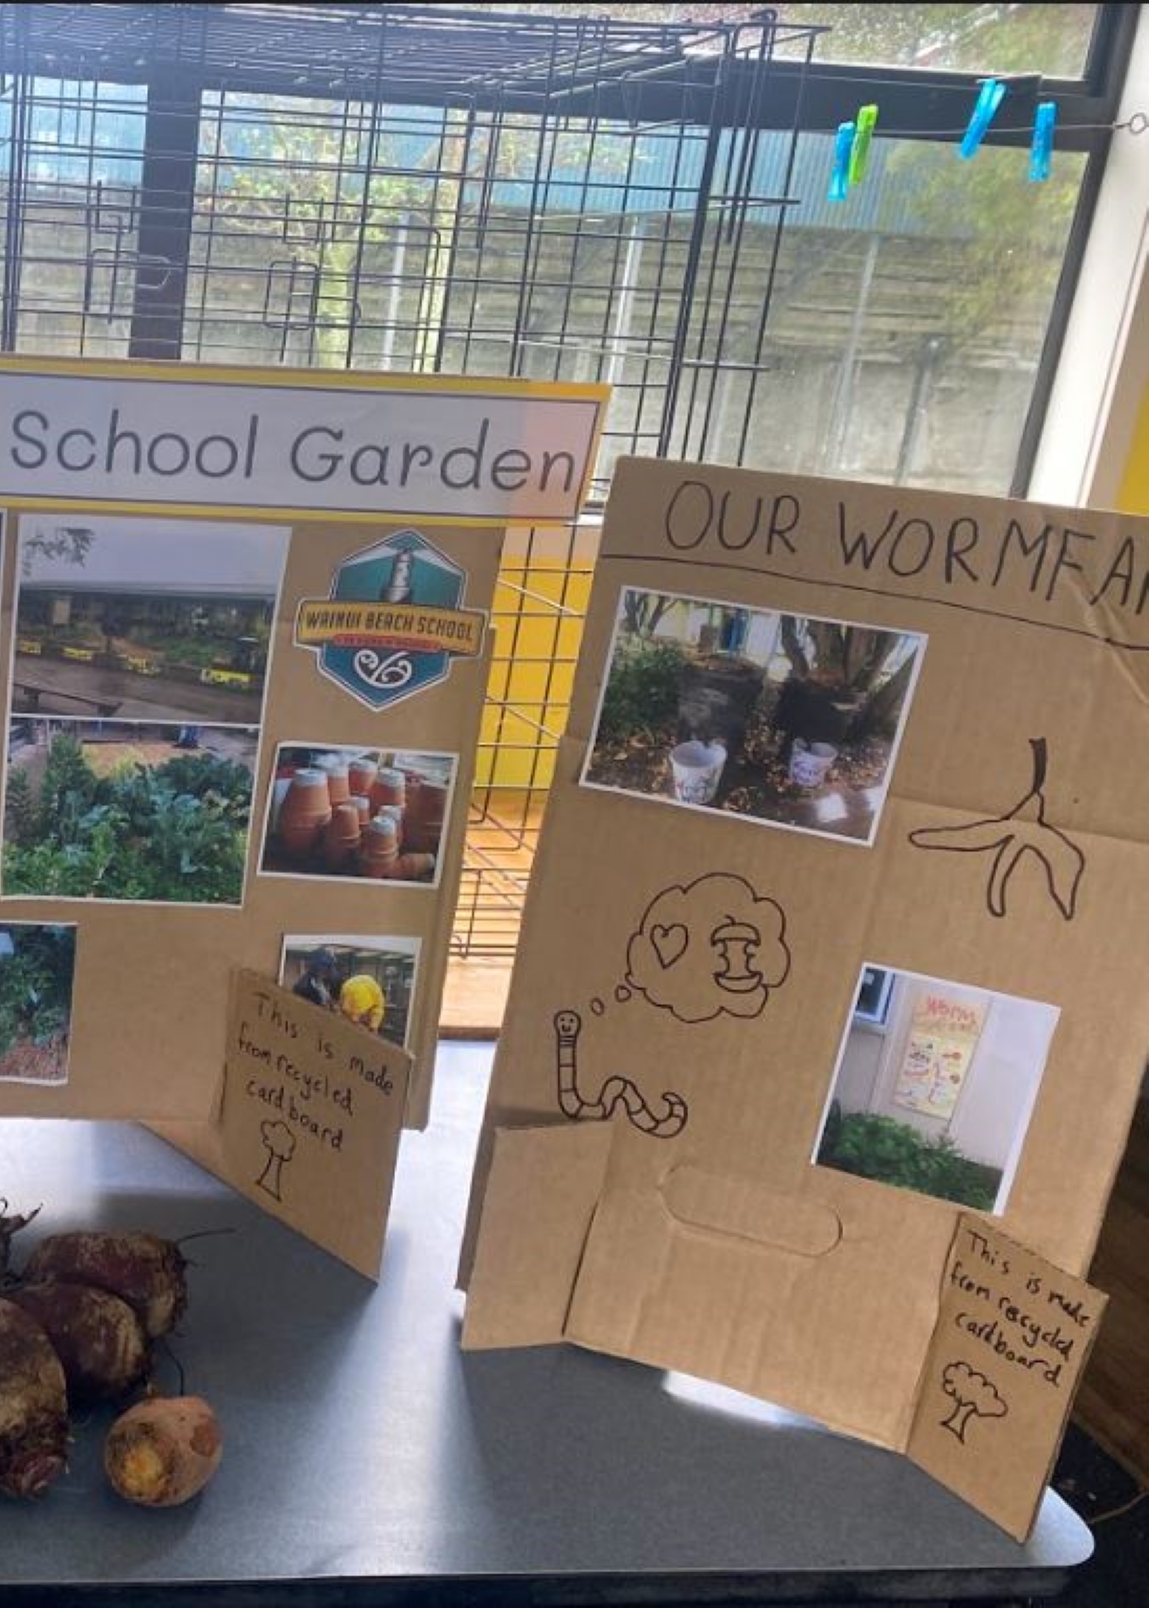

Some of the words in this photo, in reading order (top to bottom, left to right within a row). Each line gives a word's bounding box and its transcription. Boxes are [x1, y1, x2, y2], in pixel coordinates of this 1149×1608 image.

[10, 408, 259, 479] School
[290, 418, 575, 493] Garden
[665, 481, 800, 555] OUR
[306, 611, 361, 631] WAINUI
[365, 612, 415, 633] BEACH
[418, 615, 473, 642] SCHOOL
[238, 1021, 271, 1066] from
[276, 1055, 353, 1117] recycled
[254, 992, 298, 1039] This
[318, 1038, 334, 1060] is
[348, 1056, 394, 1096] made
[950, 1261, 991, 1299] from
[998, 1297, 1074, 1362] recycled
[968, 1229, 1009, 1275] This
[1026, 1272, 1042, 1294] is
[1047, 1291, 1090, 1328] made
[955, 1311, 1063, 1389] cardboard
